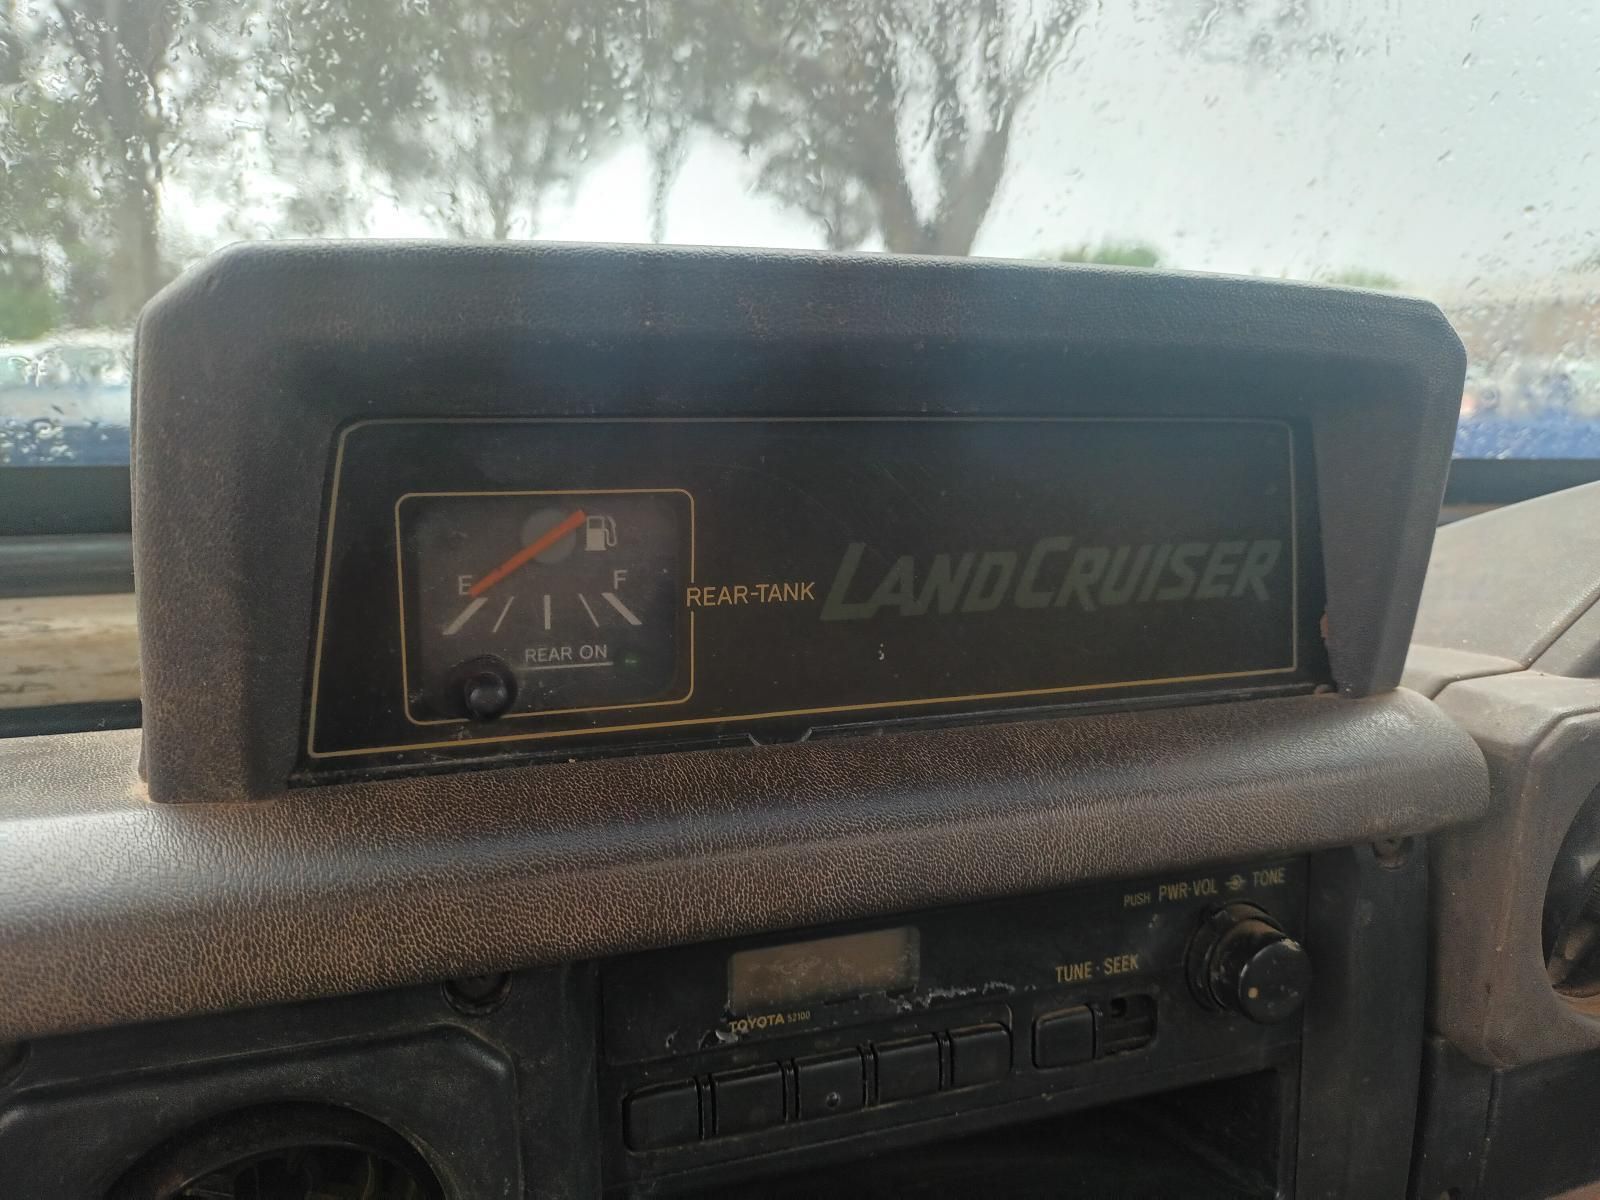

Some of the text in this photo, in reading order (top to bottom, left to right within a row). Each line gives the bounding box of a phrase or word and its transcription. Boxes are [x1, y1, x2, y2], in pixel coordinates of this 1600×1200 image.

[458, 575, 473, 595] E
[613, 570, 628, 590] F
[686, 582, 815, 607] REAR-TANK
[525, 644, 608, 662] REAR ON
[1123, 891, 1151, 907] PUSH
[1253, 867, 1285, 887] TONE
[1055, 953, 1139, 983] TUNE SEEK
[728, 1013, 784, 1034] TOYOTA
